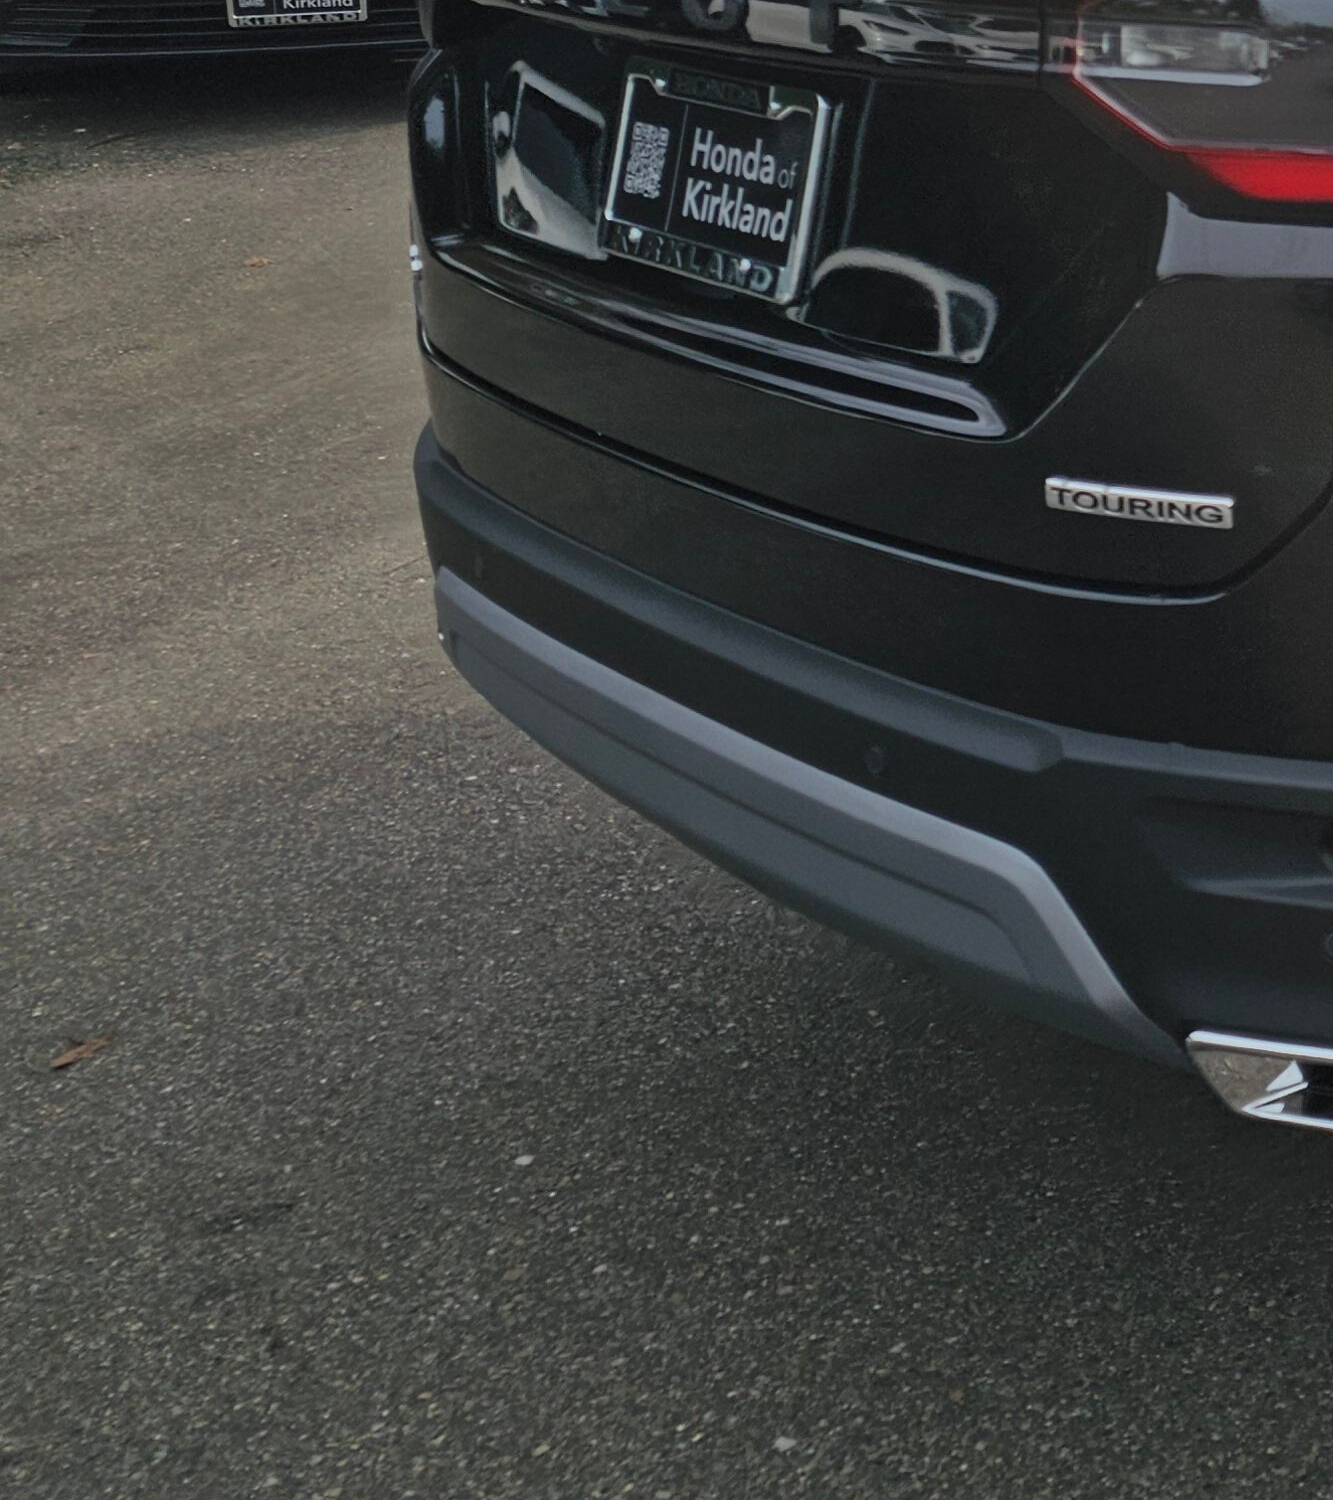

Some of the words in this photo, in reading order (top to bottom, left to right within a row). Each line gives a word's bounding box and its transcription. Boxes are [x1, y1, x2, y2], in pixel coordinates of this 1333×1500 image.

[239, 12, 358, 26] KIRKLAND
[690, 127, 776, 186] Honda
[777, 161, 798, 189] of
[681, 177, 793, 242] Kirkland
[1050, 486, 1224, 524] TOURING
